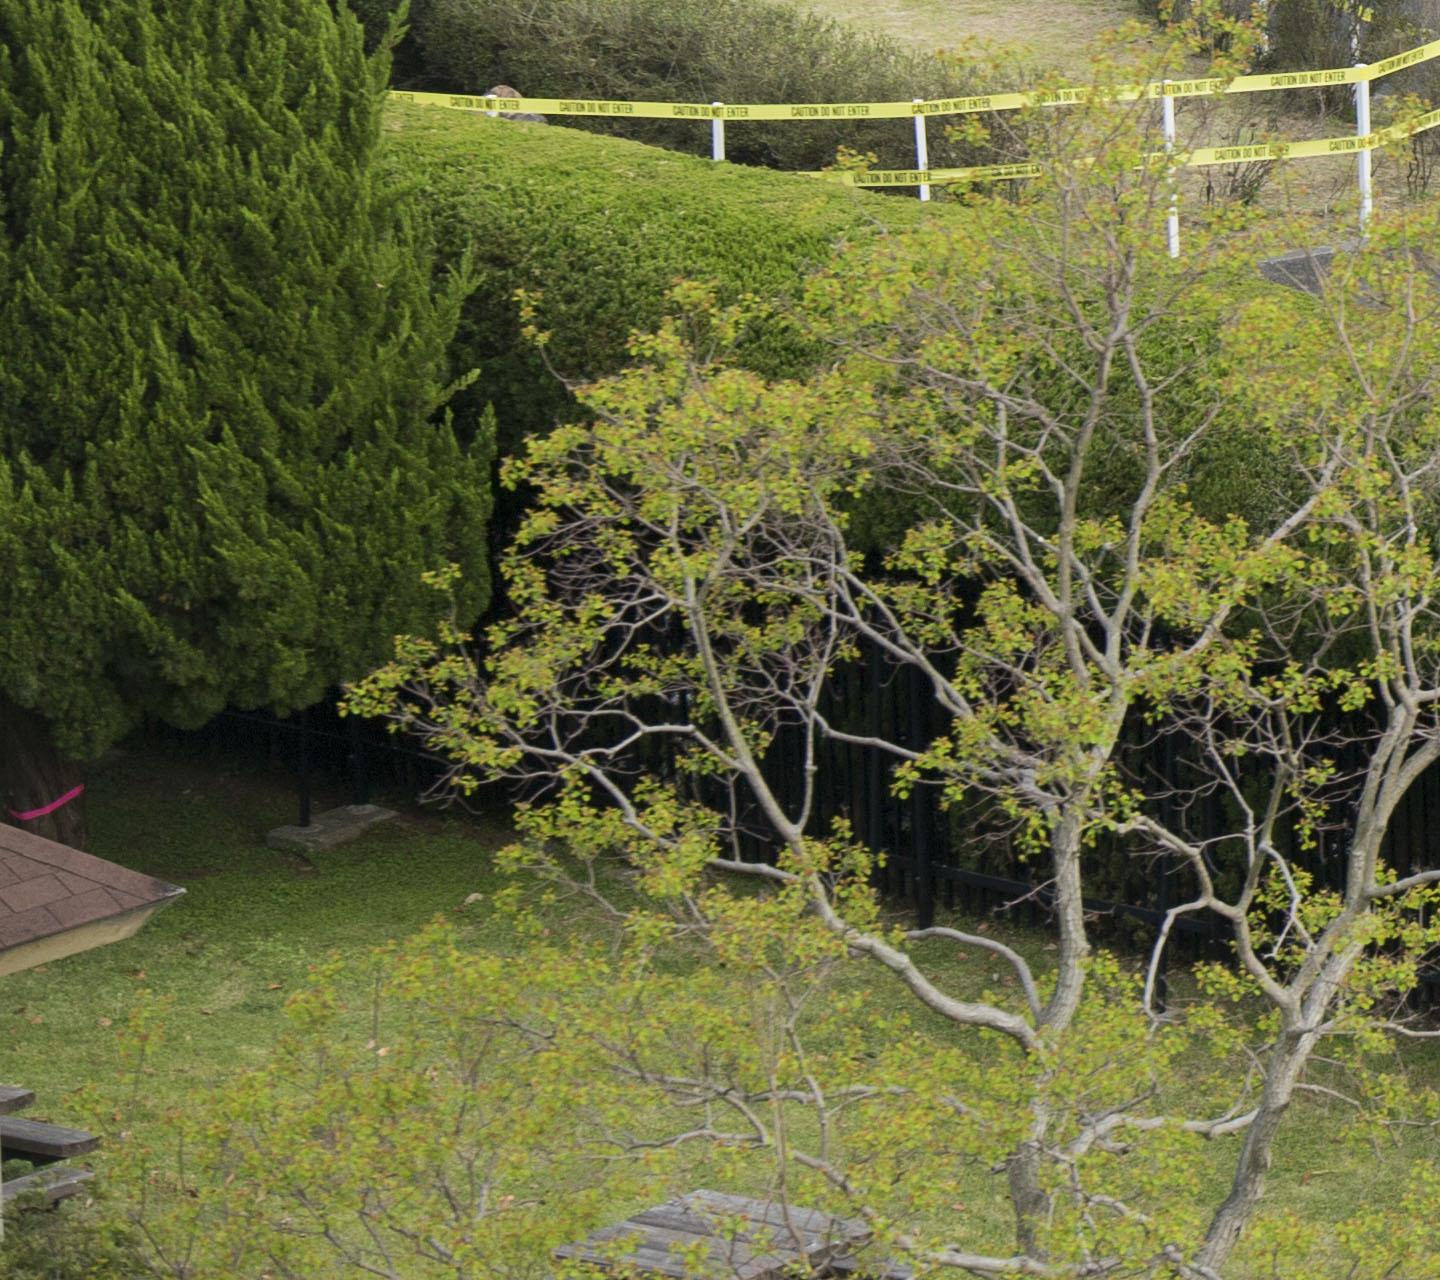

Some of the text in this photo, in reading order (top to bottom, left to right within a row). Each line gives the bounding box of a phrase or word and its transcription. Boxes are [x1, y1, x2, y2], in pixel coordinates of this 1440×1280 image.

[1270, 71, 1345, 86] CAUTION DO NOT ENTER
[1195, 81, 1208, 92] NOT
[450, 96, 520, 110] CAUTION DO NOT ENTER
[559, 101, 633, 114] CAUTION DO NOT ENTER
[911, 98, 990, 114] CAUTION DO NOT ENTER
[673, 105, 748, 118] CAUTION DO NOT ENTER
[791, 105, 870, 117] CAUTION DO NOT ENTER
[1329, 139, 1355, 150] CAUTION
[1215, 149, 1241, 160] CAUTION
[1243, 148, 1252, 158] DO
[1254, 147, 1266, 157] NOT
[853, 172, 881, 183] CAUTION
[883, 172, 892, 183] DO
[894, 172, 907, 183] NOT
